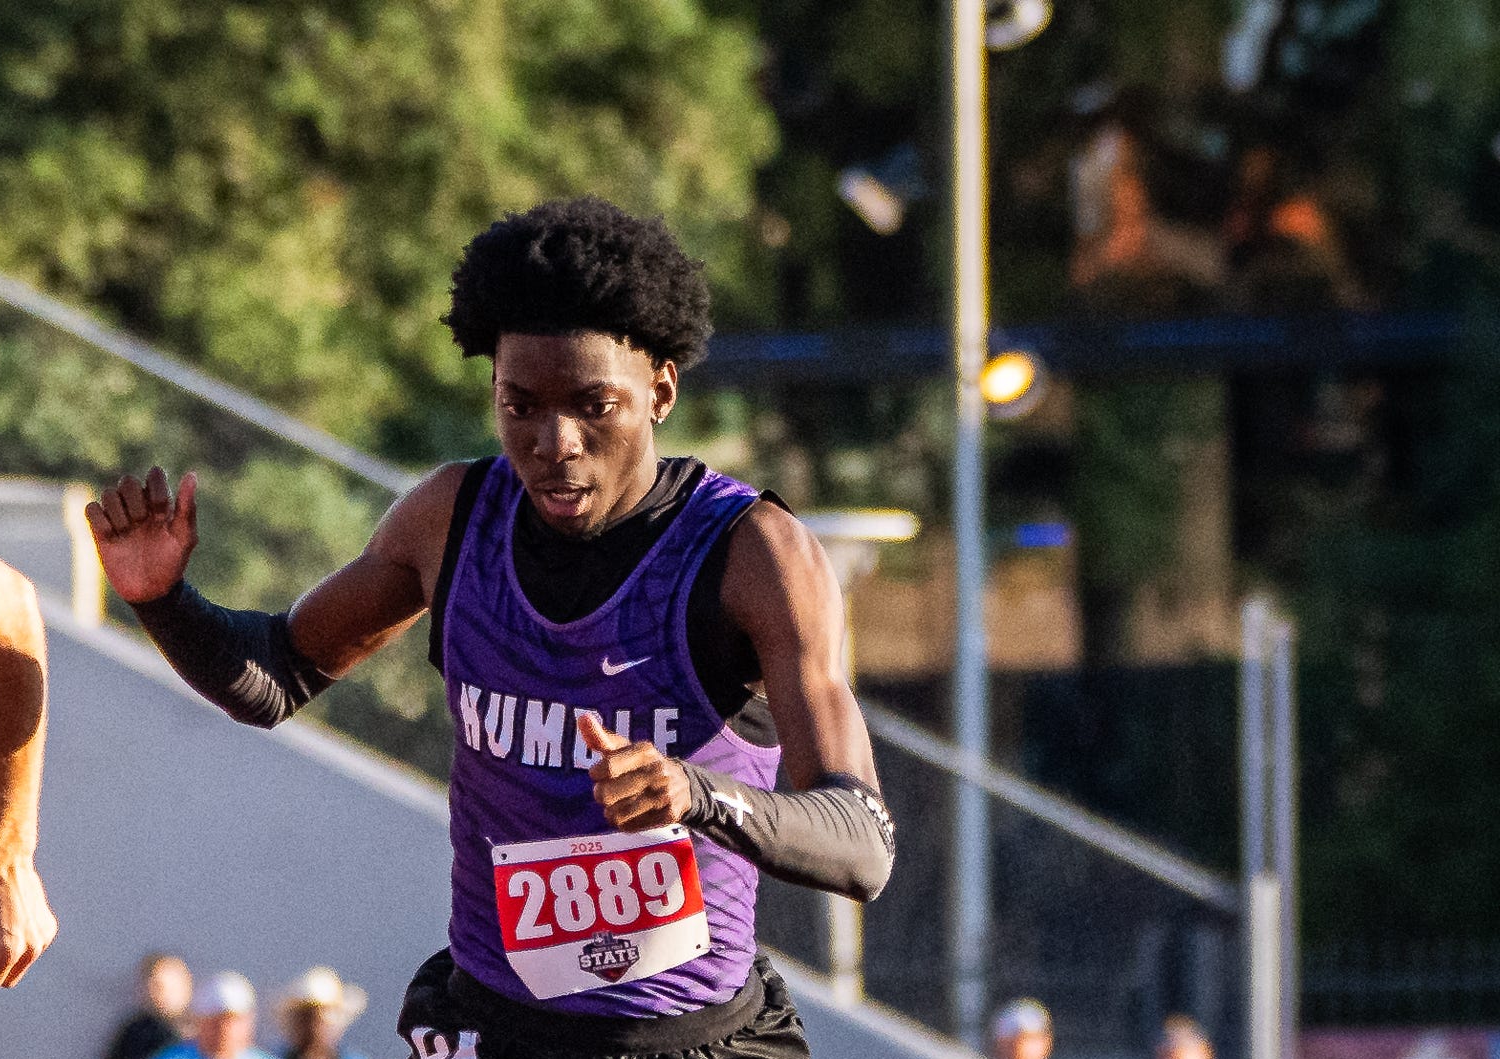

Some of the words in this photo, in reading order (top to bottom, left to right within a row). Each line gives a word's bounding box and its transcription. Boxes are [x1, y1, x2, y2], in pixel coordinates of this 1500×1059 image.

[570, 841, 603, 855] 2025
[508, 851, 686, 941] 2889
[579, 947, 638, 969] STATE
